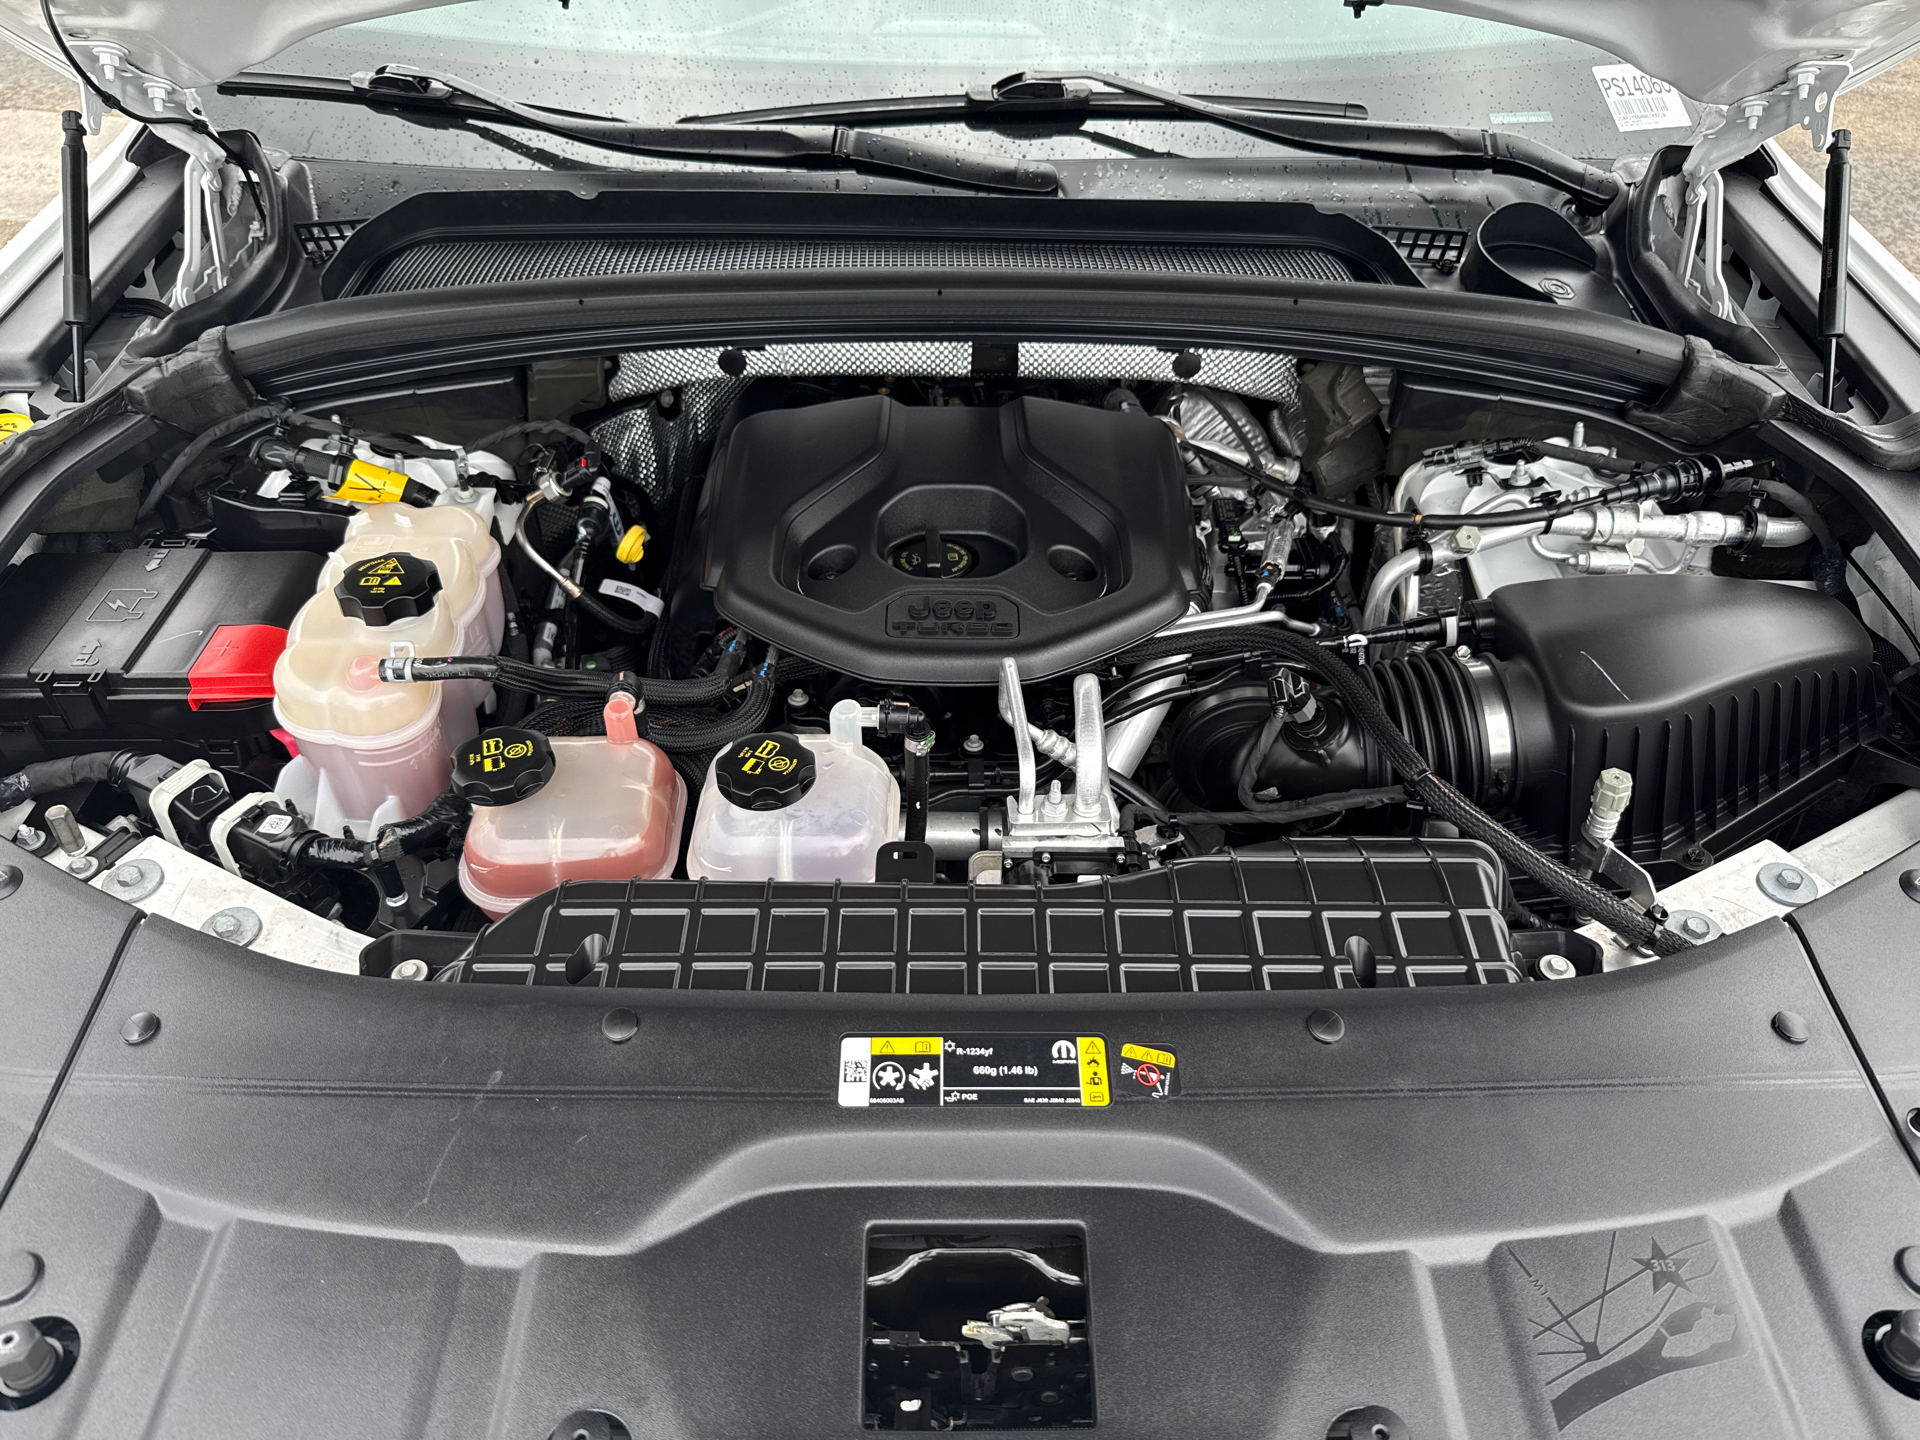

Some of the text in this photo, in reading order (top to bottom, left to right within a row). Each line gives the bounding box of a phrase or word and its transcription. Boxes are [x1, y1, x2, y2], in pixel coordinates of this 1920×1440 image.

[908, 596, 997, 620] Jeep
[891, 621, 1013, 635] TURBO
[956, 1048, 994, 1057] R-1234yf
[973, 1066, 1038, 1076] 660g (1.46 lb)
[1650, 1259, 1676, 1272] 313
